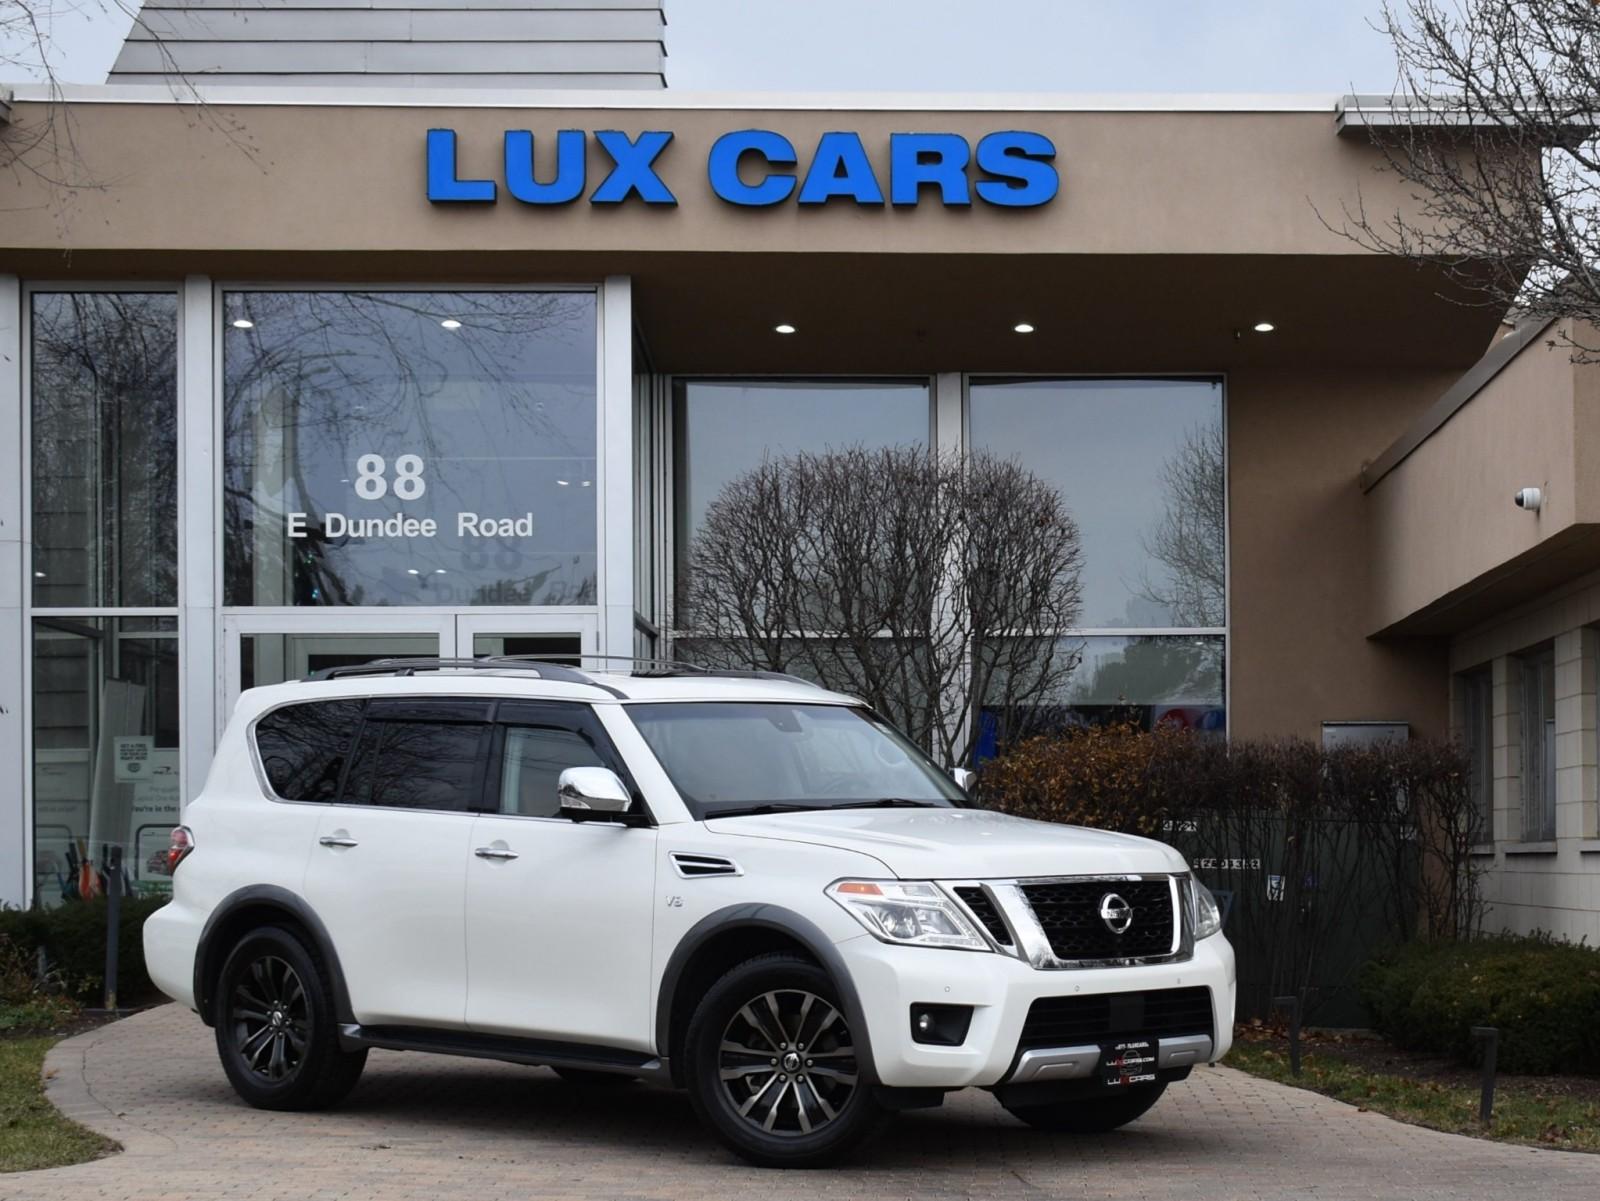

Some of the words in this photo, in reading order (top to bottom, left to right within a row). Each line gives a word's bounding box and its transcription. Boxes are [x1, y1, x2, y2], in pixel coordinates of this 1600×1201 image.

[426, 128, 678, 206] LUX
[707, 129, 1060, 207] CARS
[354, 453, 427, 501] 88
[287, 512, 308, 538] E
[325, 512, 438, 538] Dundee
[457, 512, 534, 538] Road
